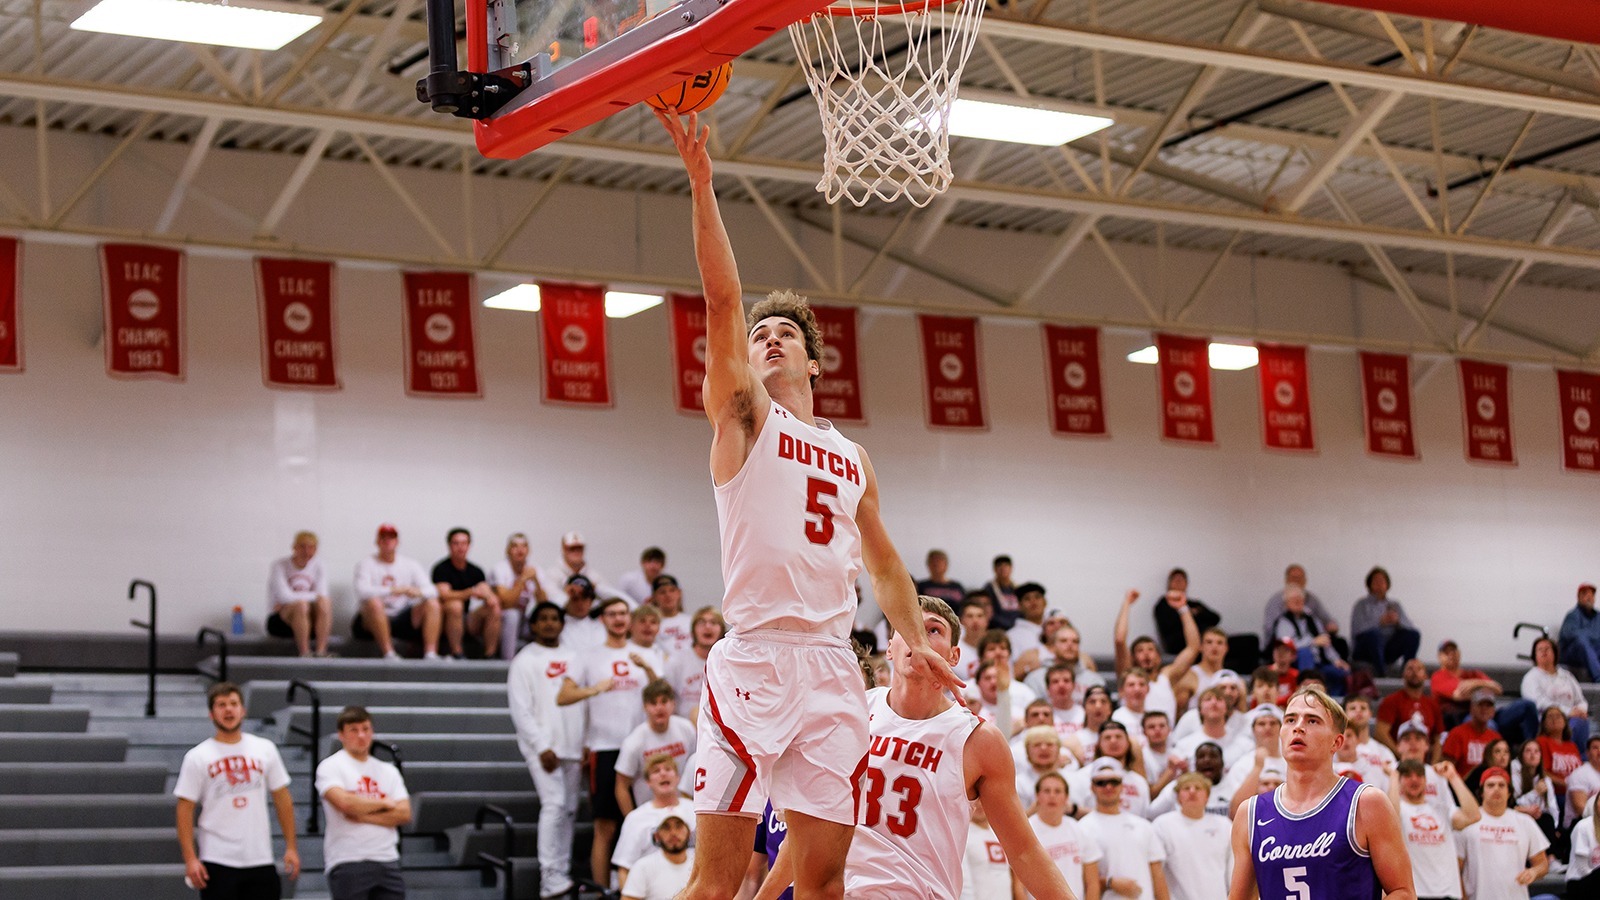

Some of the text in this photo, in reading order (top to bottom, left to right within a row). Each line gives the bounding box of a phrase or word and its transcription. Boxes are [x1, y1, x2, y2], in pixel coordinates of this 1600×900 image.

[124, 262, 161, 282] IIAC
[277, 276, 314, 296] IIAC
[416, 288, 453, 307] IIAC
[118, 328, 170, 347] CHAMPS
[274, 339, 325, 359] CHAMPS
[415, 350, 468, 368] CHAMPS
[551, 359, 600, 378] CHAMPS
[933, 387, 973, 404] CHAMPS
[1057, 394, 1096, 411] CHAMPS
[1166, 401, 1204, 420] CHAMPS
[1267, 410, 1305, 429] CHAMPS
[1371, 417, 1407, 436] CHAMPS
[1471, 424, 1505, 442] CHAMPS
[1569, 435, 1599, 452] CHAMPS
[778, 432, 860, 486] DUTCH
[804, 475, 838, 546] 5
[868, 734, 943, 773] UTCH
[694, 767, 706, 791] C
[864, 766, 923, 839] 33
[1258, 831, 1336, 863] Cornell
[1282, 866, 1311, 900] 5
